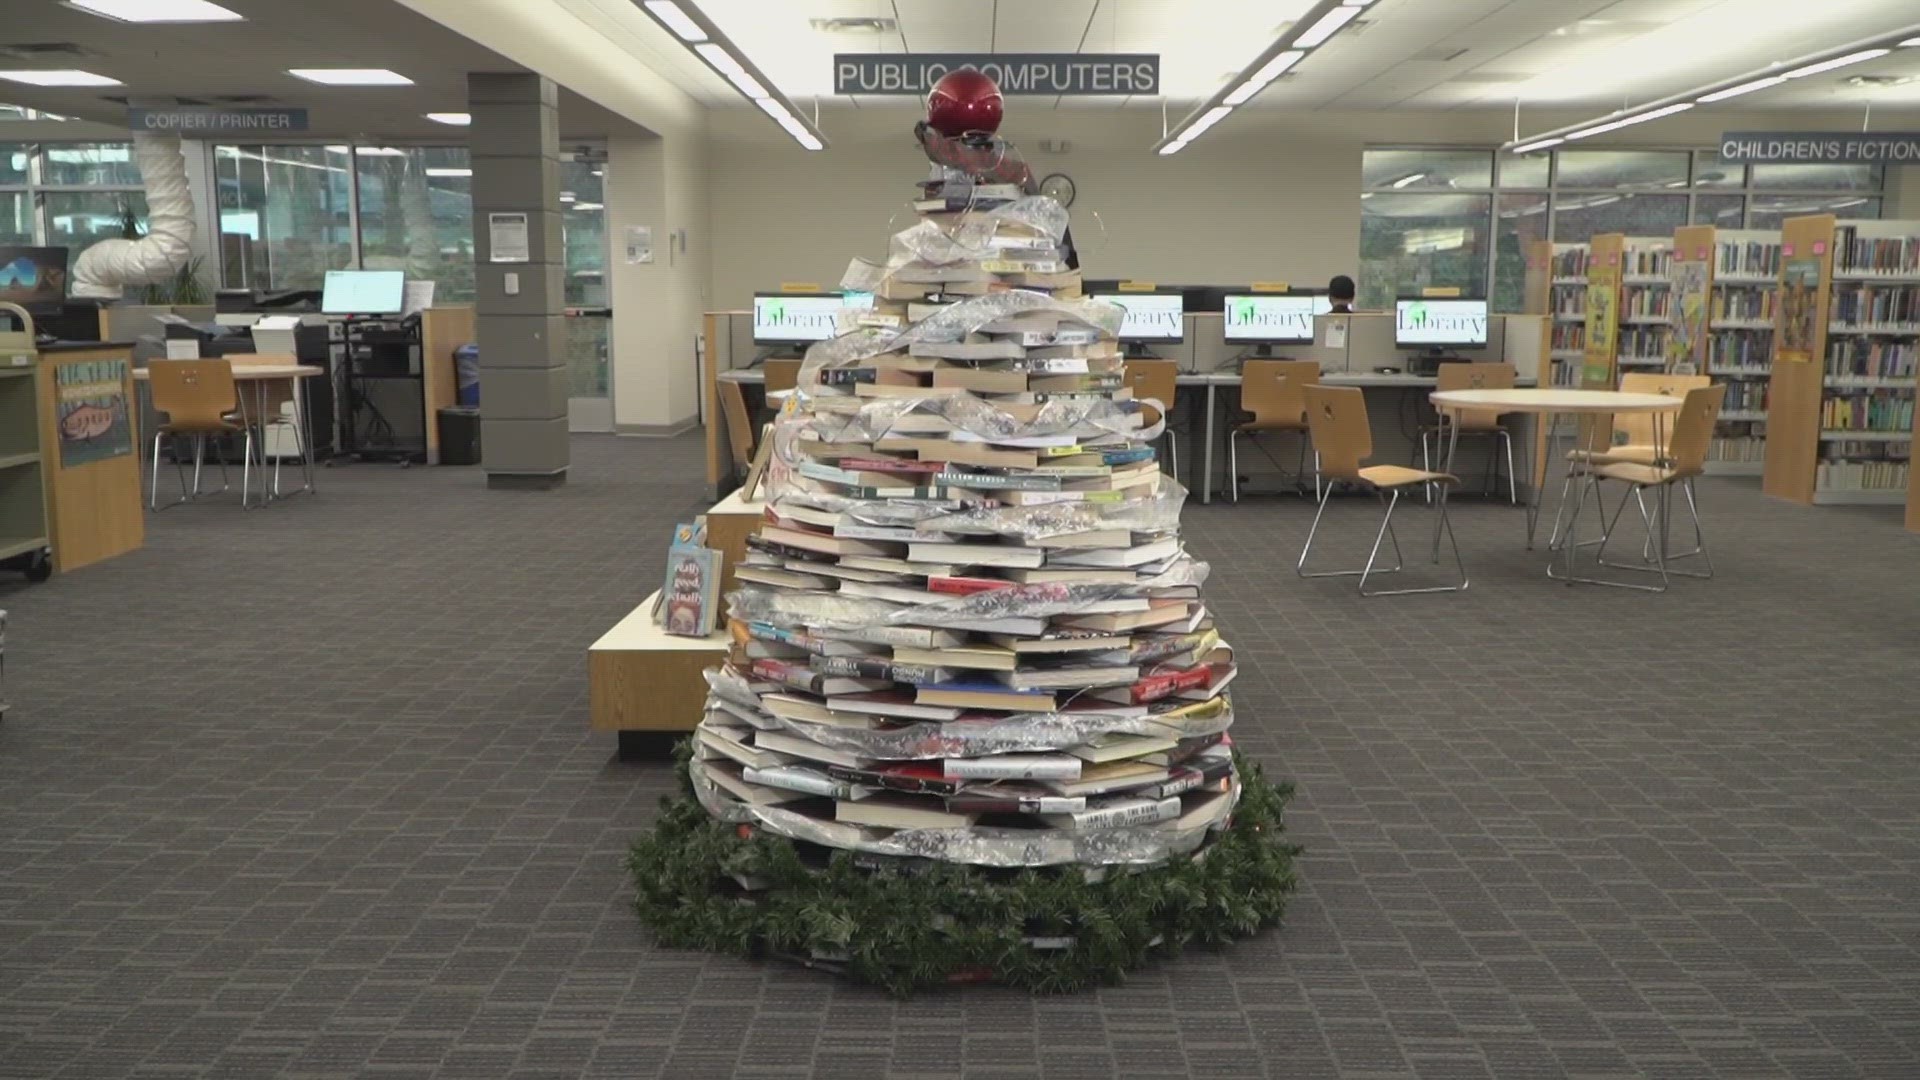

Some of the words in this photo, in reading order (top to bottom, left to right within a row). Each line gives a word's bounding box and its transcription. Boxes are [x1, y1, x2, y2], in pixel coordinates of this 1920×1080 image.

[838, 63, 947, 89] PUBLIC
[959, 63, 1154, 89] OMPUTERS
[145, 113, 206, 128] COPIER
[210, 114, 216, 128] /
[220, 114, 290, 129] PRINTER
[1721, 140, 1840, 159] CHILDREN'S
[1227, 304, 1313, 337] Library
[1398, 308, 1486, 341] Library
